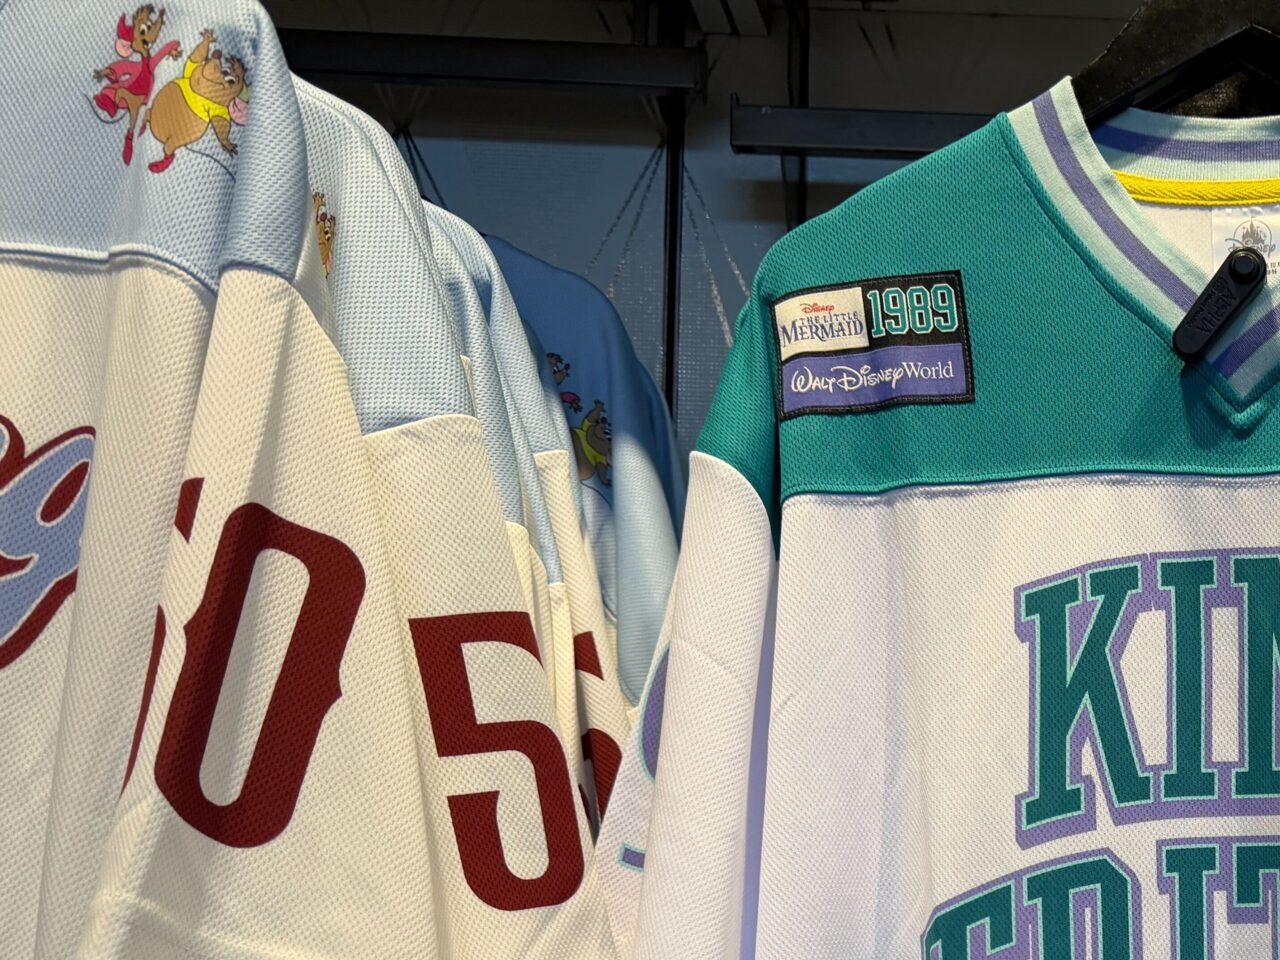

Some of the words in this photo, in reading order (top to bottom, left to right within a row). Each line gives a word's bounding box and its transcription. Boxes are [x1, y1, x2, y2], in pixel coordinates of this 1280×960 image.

[799, 315, 820, 325] THE
[823, 311, 860, 324] LITTLE
[867, 283, 959, 339] 1989
[780, 319, 864, 348] MERMAID
[901, 360, 954, 380] World
[118, 477, 366, 848] 0
